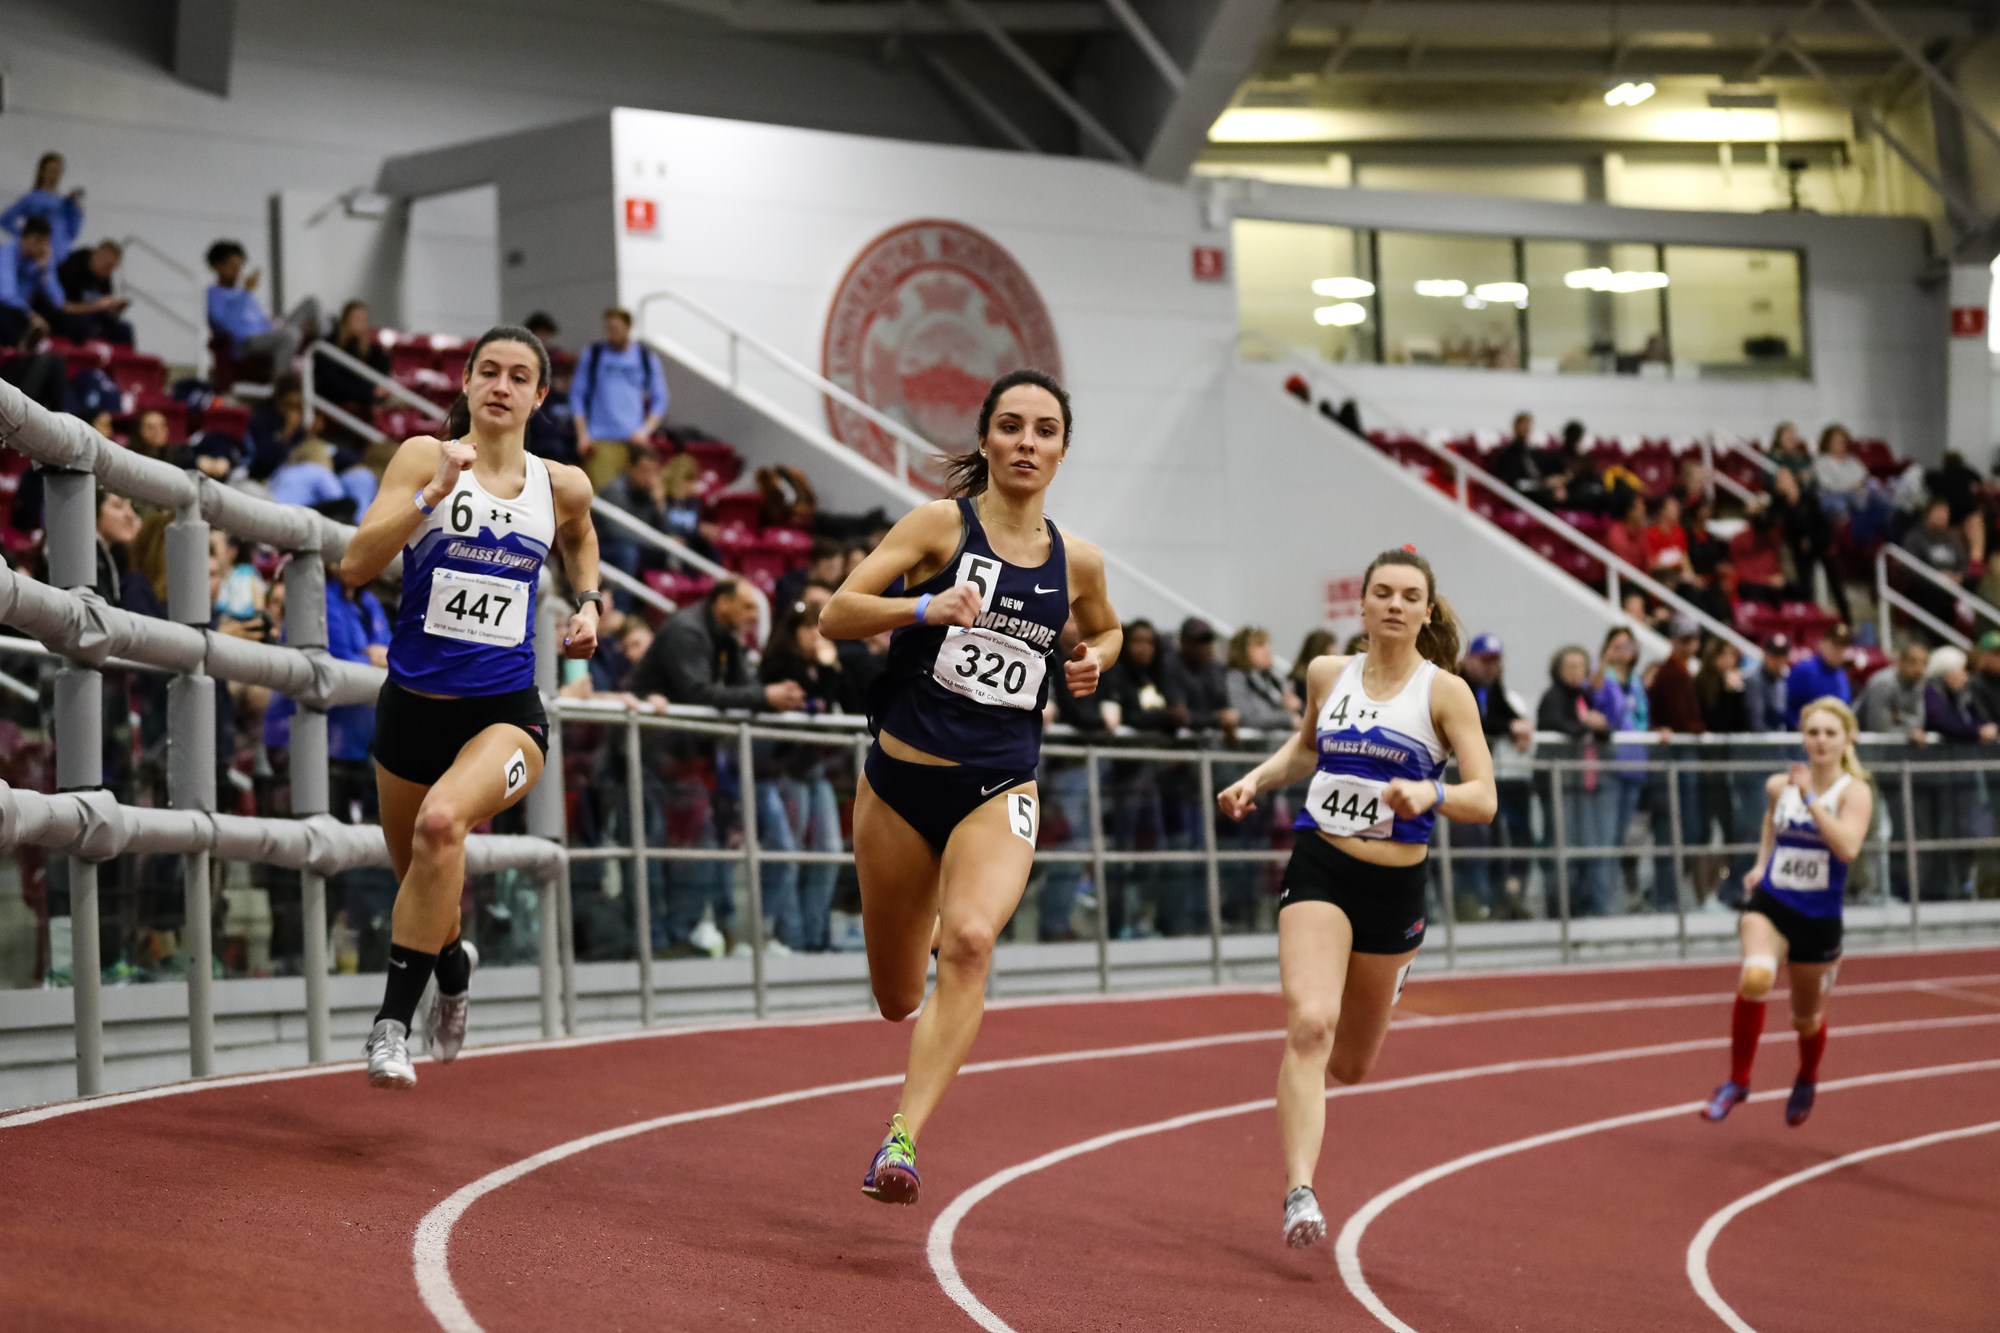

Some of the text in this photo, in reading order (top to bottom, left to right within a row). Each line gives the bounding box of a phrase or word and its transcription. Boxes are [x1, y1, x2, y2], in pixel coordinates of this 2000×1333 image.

[450, 490, 474, 533] 6
[445, 589, 512, 627] 447
[1000, 596, 1024, 611] NEW
[974, 611, 1057, 649] MPSHIRE
[955, 643, 1027, 695] 320
[1329, 694, 1351, 727] 4
[508, 760, 525, 789] 6
[1018, 795, 1033, 839] 5
[1321, 789, 1379, 826] 444
[1780, 859, 1819, 880] 460
